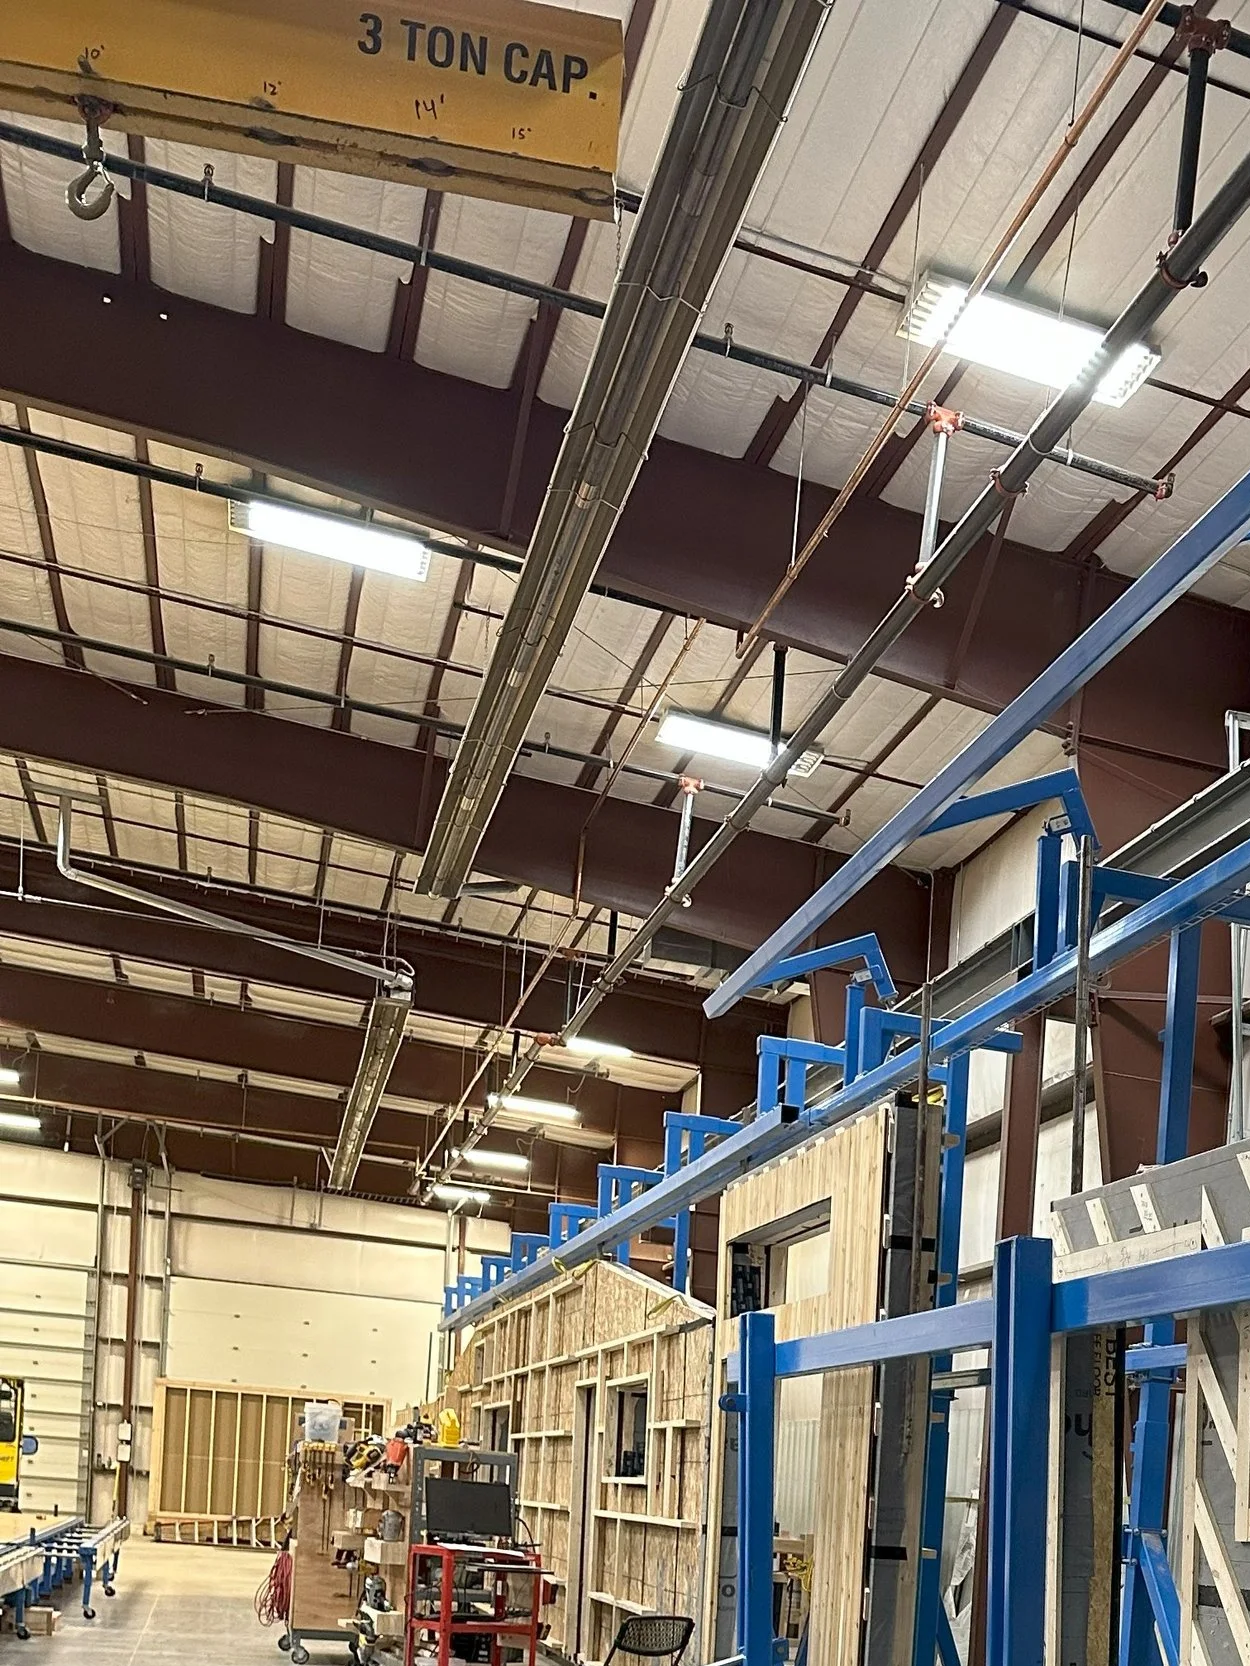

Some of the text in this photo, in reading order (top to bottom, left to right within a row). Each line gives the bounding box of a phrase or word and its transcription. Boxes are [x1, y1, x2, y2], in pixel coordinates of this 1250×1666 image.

[357, 12, 597, 100] 3 TON CAP.
